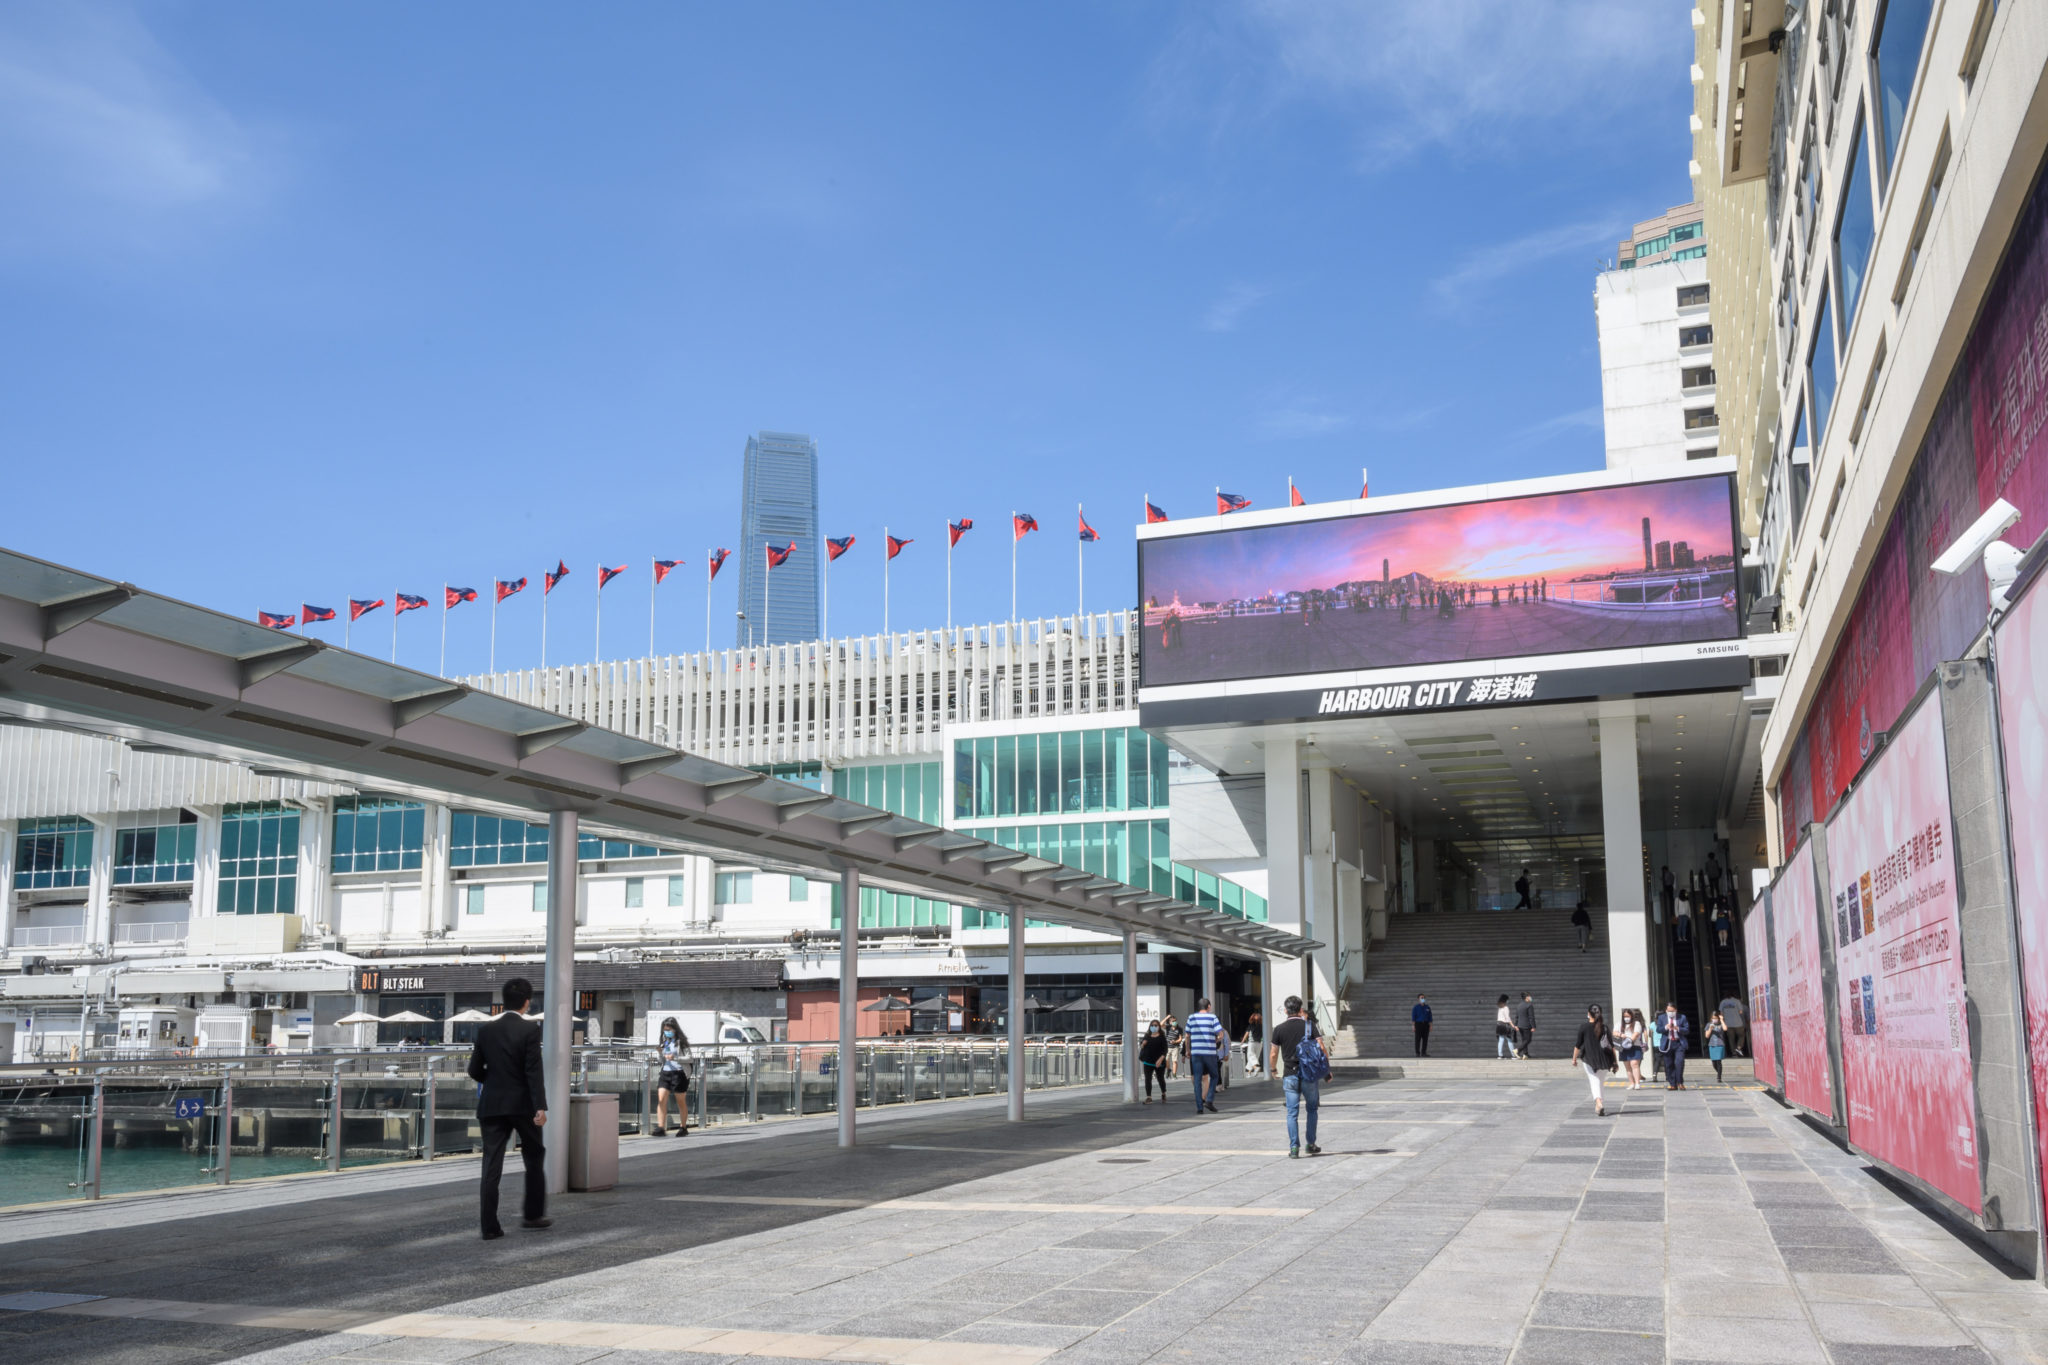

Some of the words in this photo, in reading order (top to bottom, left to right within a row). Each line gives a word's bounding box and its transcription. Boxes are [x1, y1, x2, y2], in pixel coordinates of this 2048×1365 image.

[1697, 644, 1740, 654] SAMSUNG
[1318, 684, 1412, 714] HARBOUR
[1414, 680, 1463, 707] CITY
[1466, 673, 1538, 702] 海港城
[1928, 880, 1945, 900] Voucher
[1934, 928, 1949, 953] CARD
[361, 972, 379, 990] BLT
[383, 978, 399, 990] BLT
[399, 977, 424, 989] STEAK
